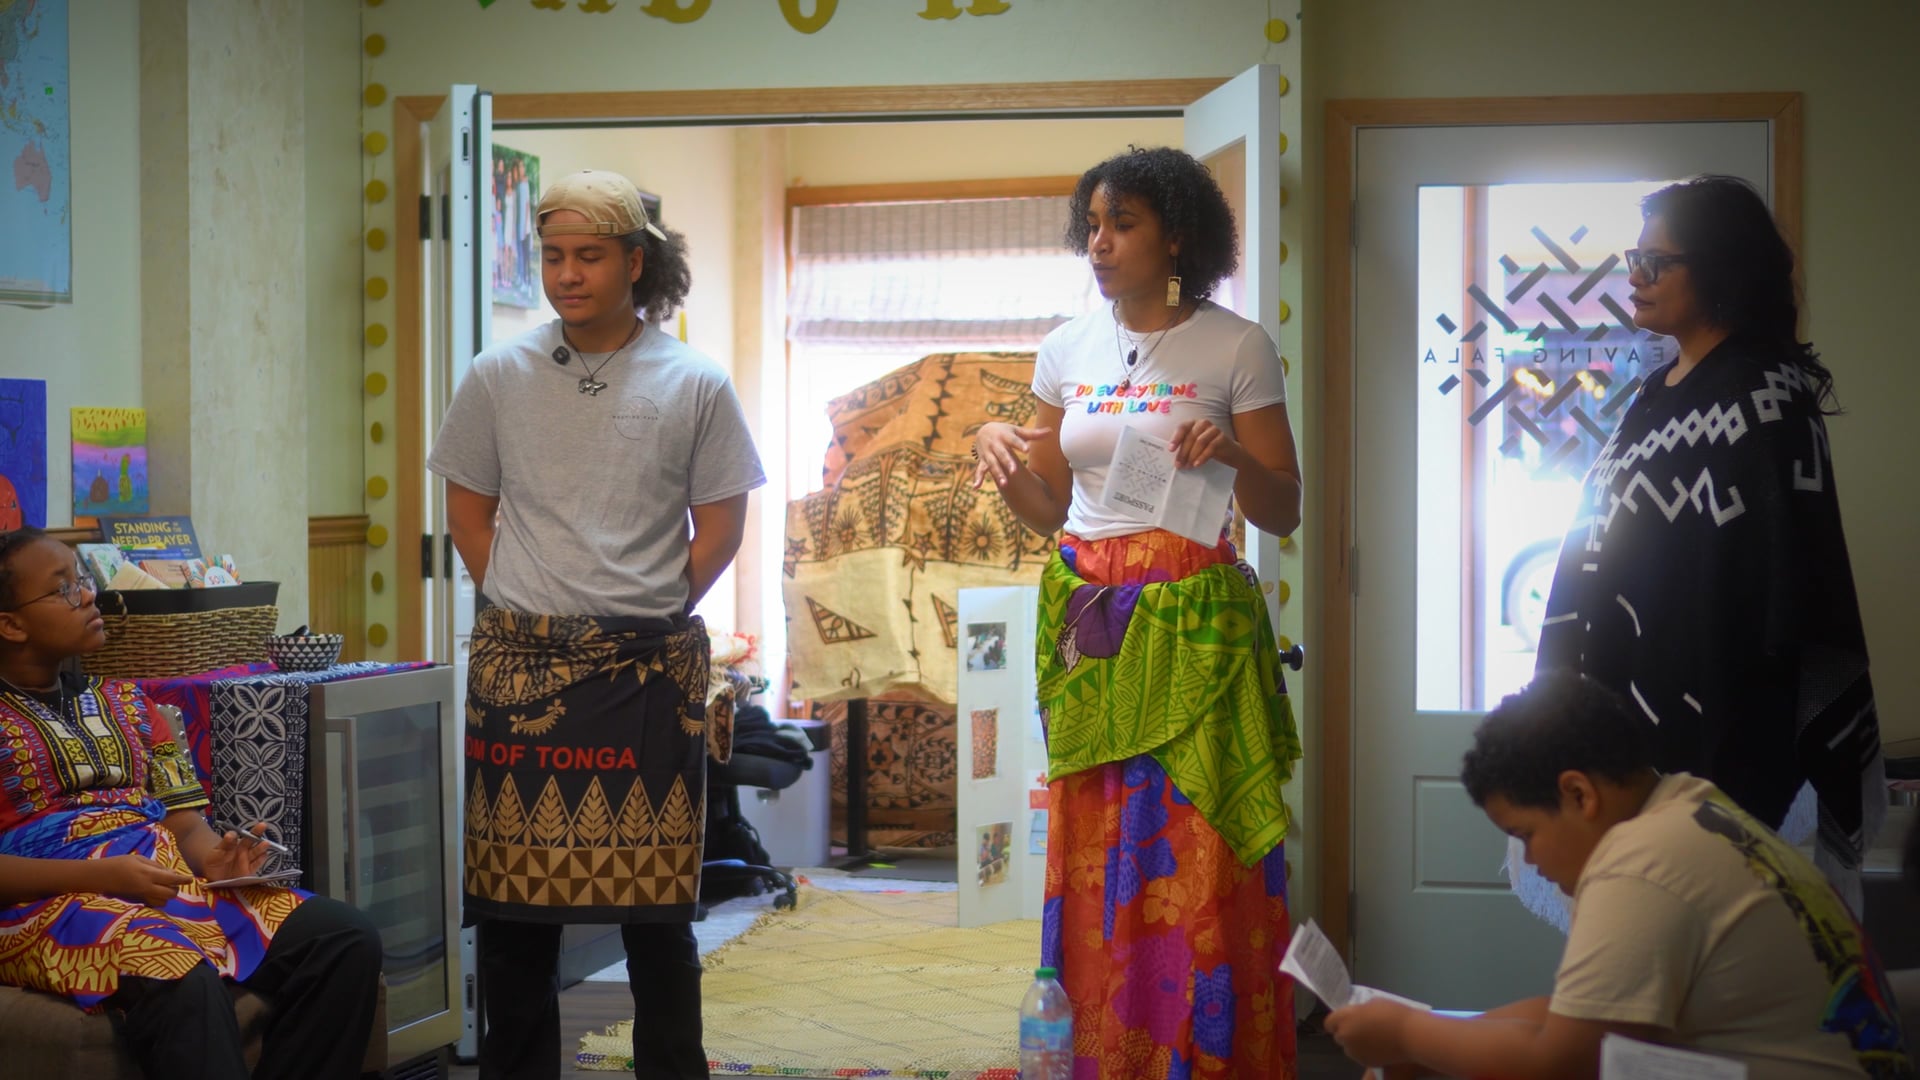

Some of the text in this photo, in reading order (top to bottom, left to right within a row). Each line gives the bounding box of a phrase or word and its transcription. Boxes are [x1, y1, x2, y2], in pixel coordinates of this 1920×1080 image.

[1075, 383, 1198, 398] DO EVERYTHING
[1087, 400, 1172, 414] WITH LOVE
[113, 521, 171, 534] STANDING
[111, 535, 141, 546] NEED
[148, 533, 192, 546] PRAYER
[490, 742, 526, 767] OF
[535, 745, 639, 770] TONGA
